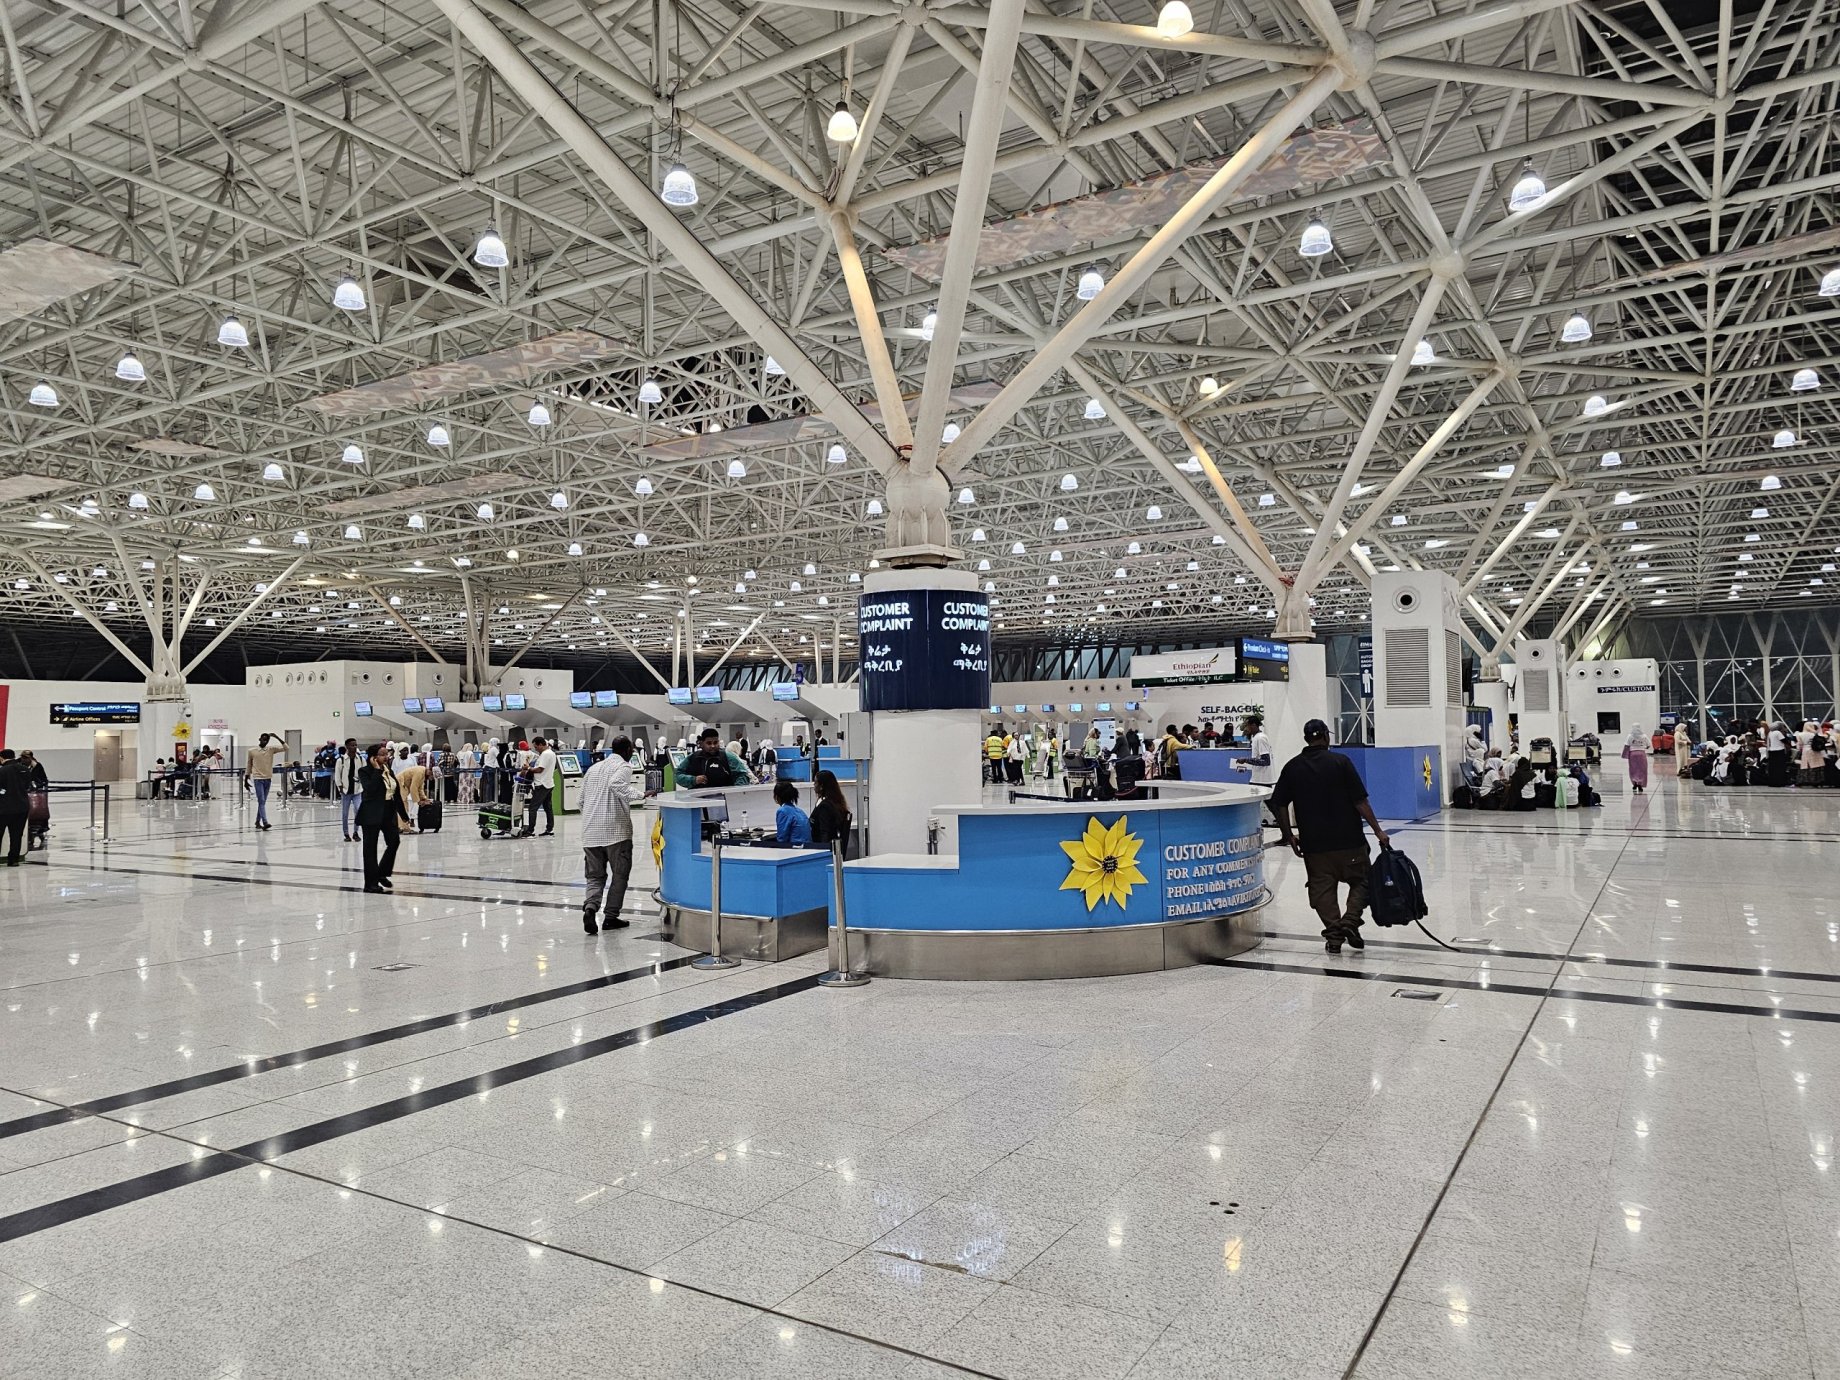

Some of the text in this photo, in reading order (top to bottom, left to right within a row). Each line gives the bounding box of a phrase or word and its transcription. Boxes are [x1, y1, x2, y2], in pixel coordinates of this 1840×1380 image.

[1172, 662, 1211, 670] Ethiopian
[1164, 841, 1226, 862] CUSTOMER
[1166, 868, 1190, 880] FOR
[1192, 864, 1215, 878] ANY
